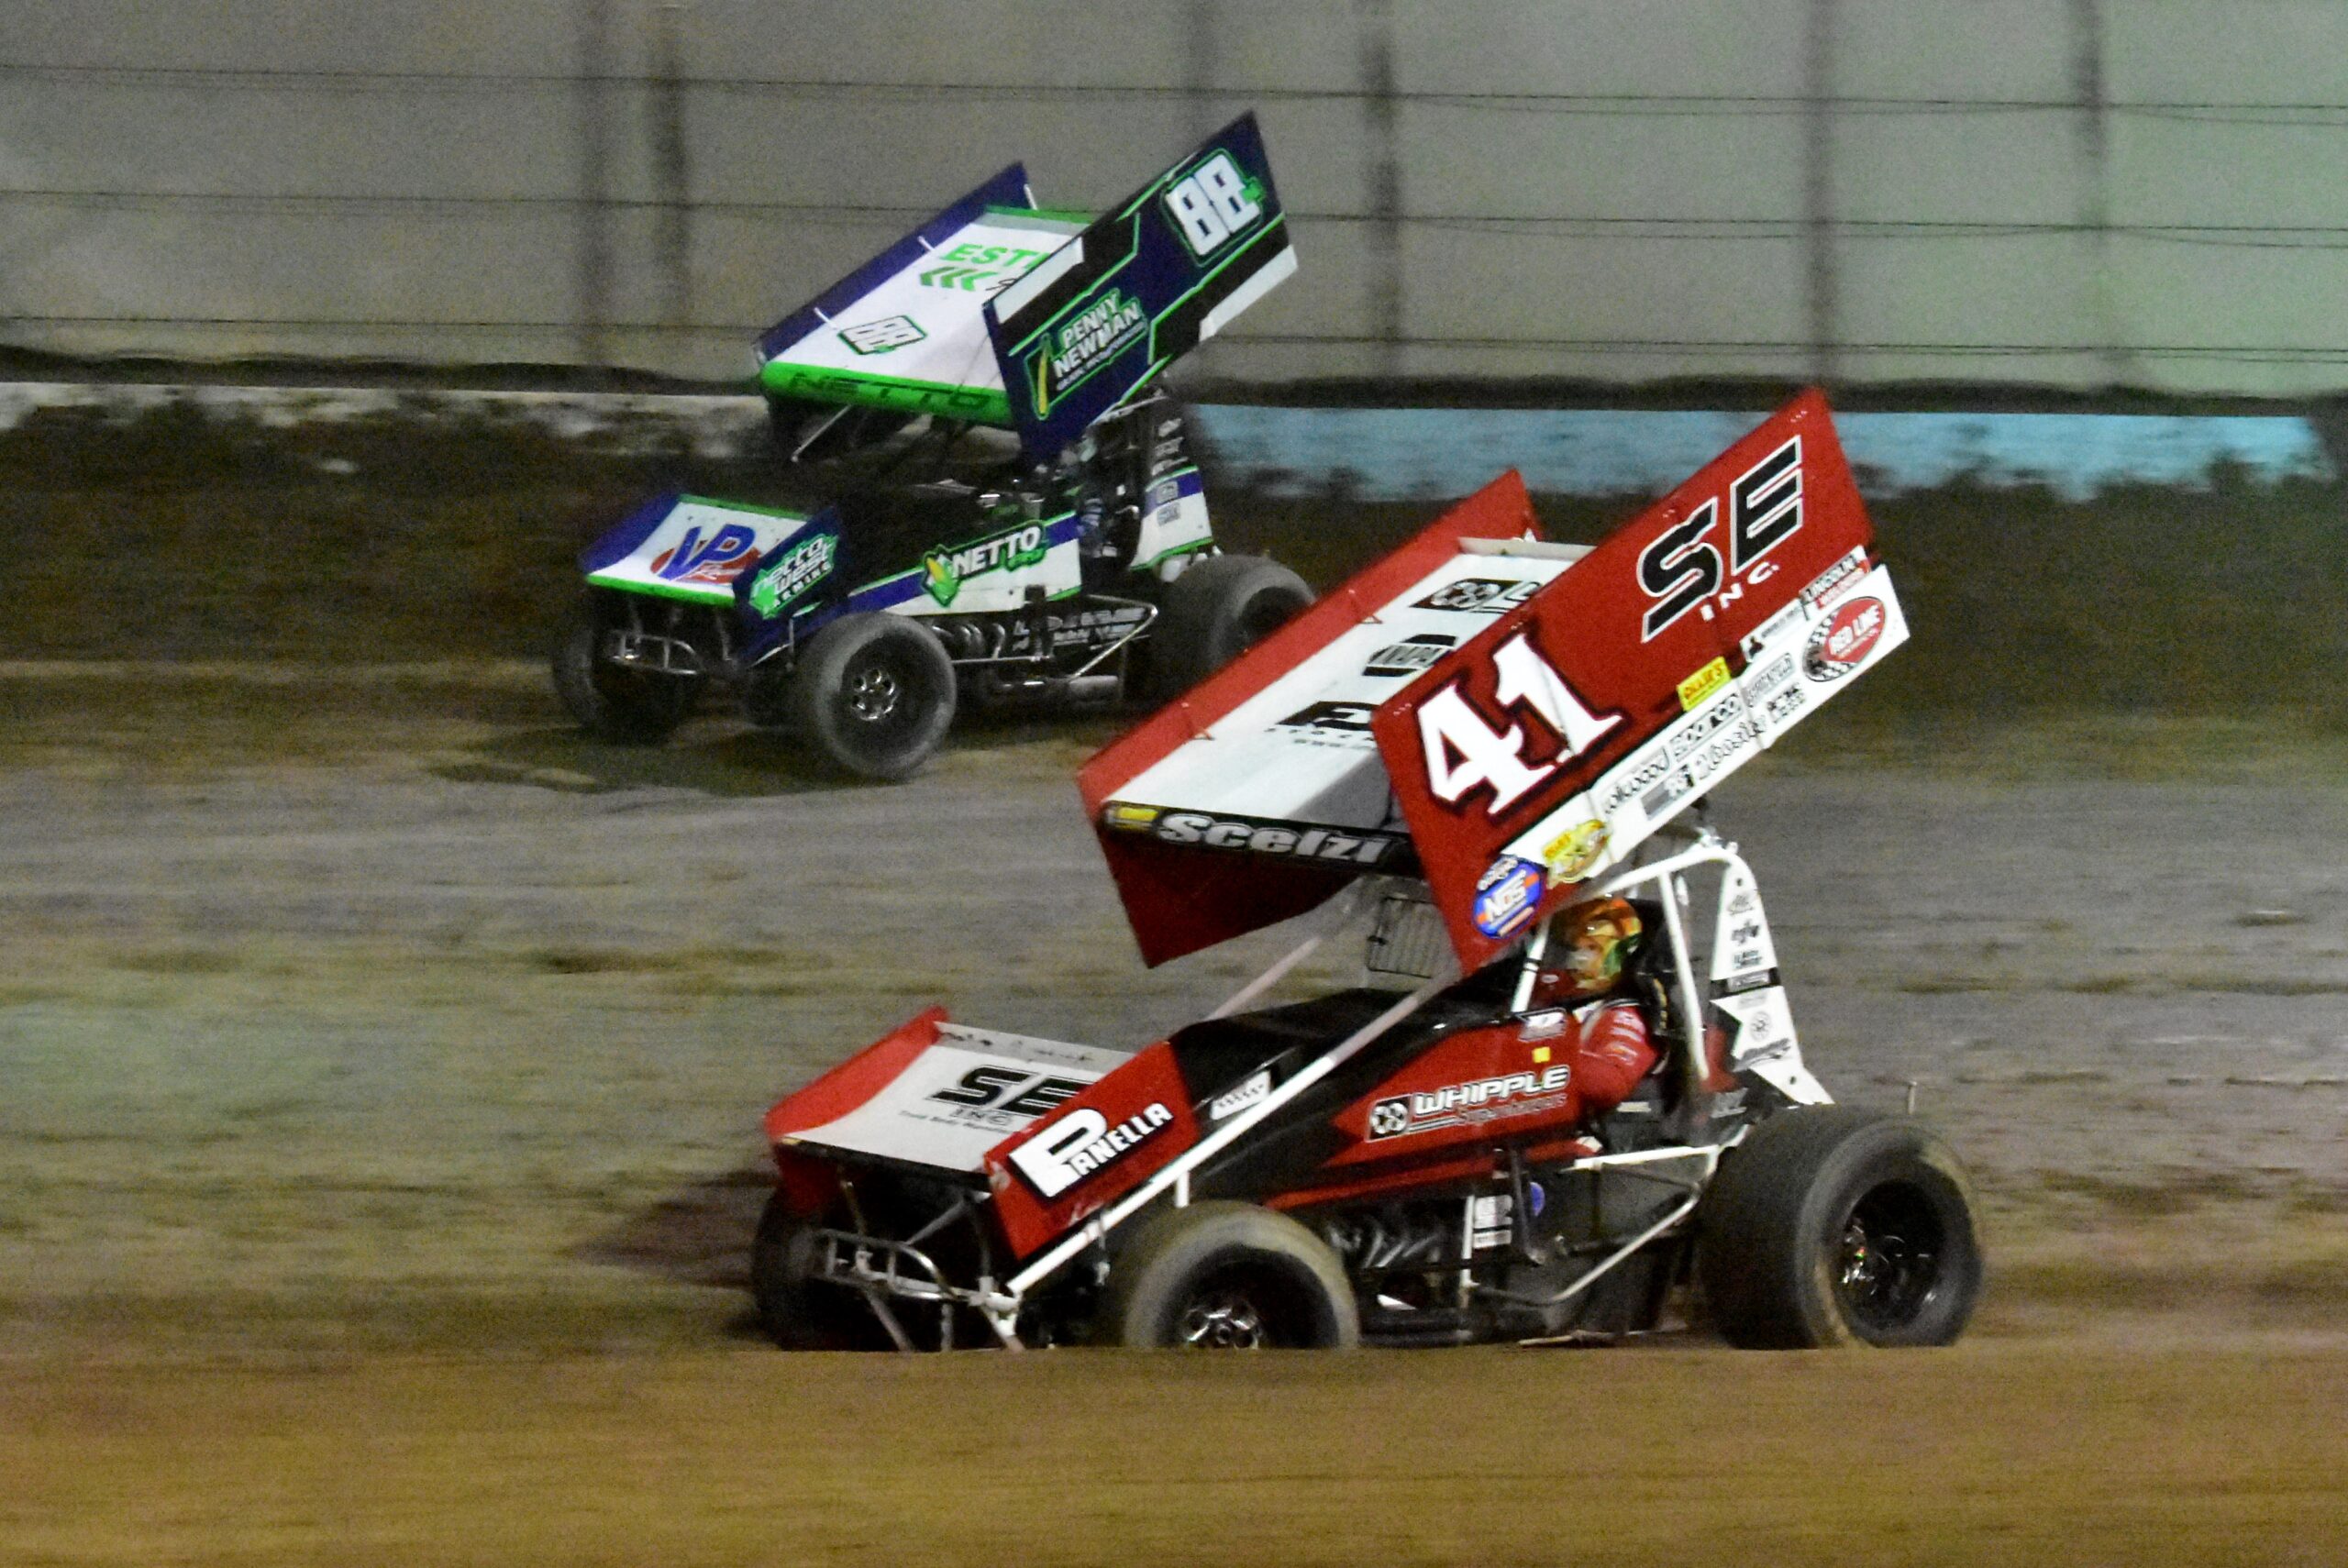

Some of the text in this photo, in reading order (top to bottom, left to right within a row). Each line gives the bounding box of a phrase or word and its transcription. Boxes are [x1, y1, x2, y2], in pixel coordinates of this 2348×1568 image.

[1165, 154, 1260, 256] 88
[1053, 302, 1140, 378] NEWMAN
[1061, 293, 1119, 349] PENNY
[658, 524, 757, 581] VP
[952, 526, 1041, 580] NETTO
[1636, 435, 1803, 643] SE
[1417, 633, 1623, 814] 41
[1157, 813, 1392, 864] Scelzi
[1413, 1065, 1570, 1115] WHIPPLE
